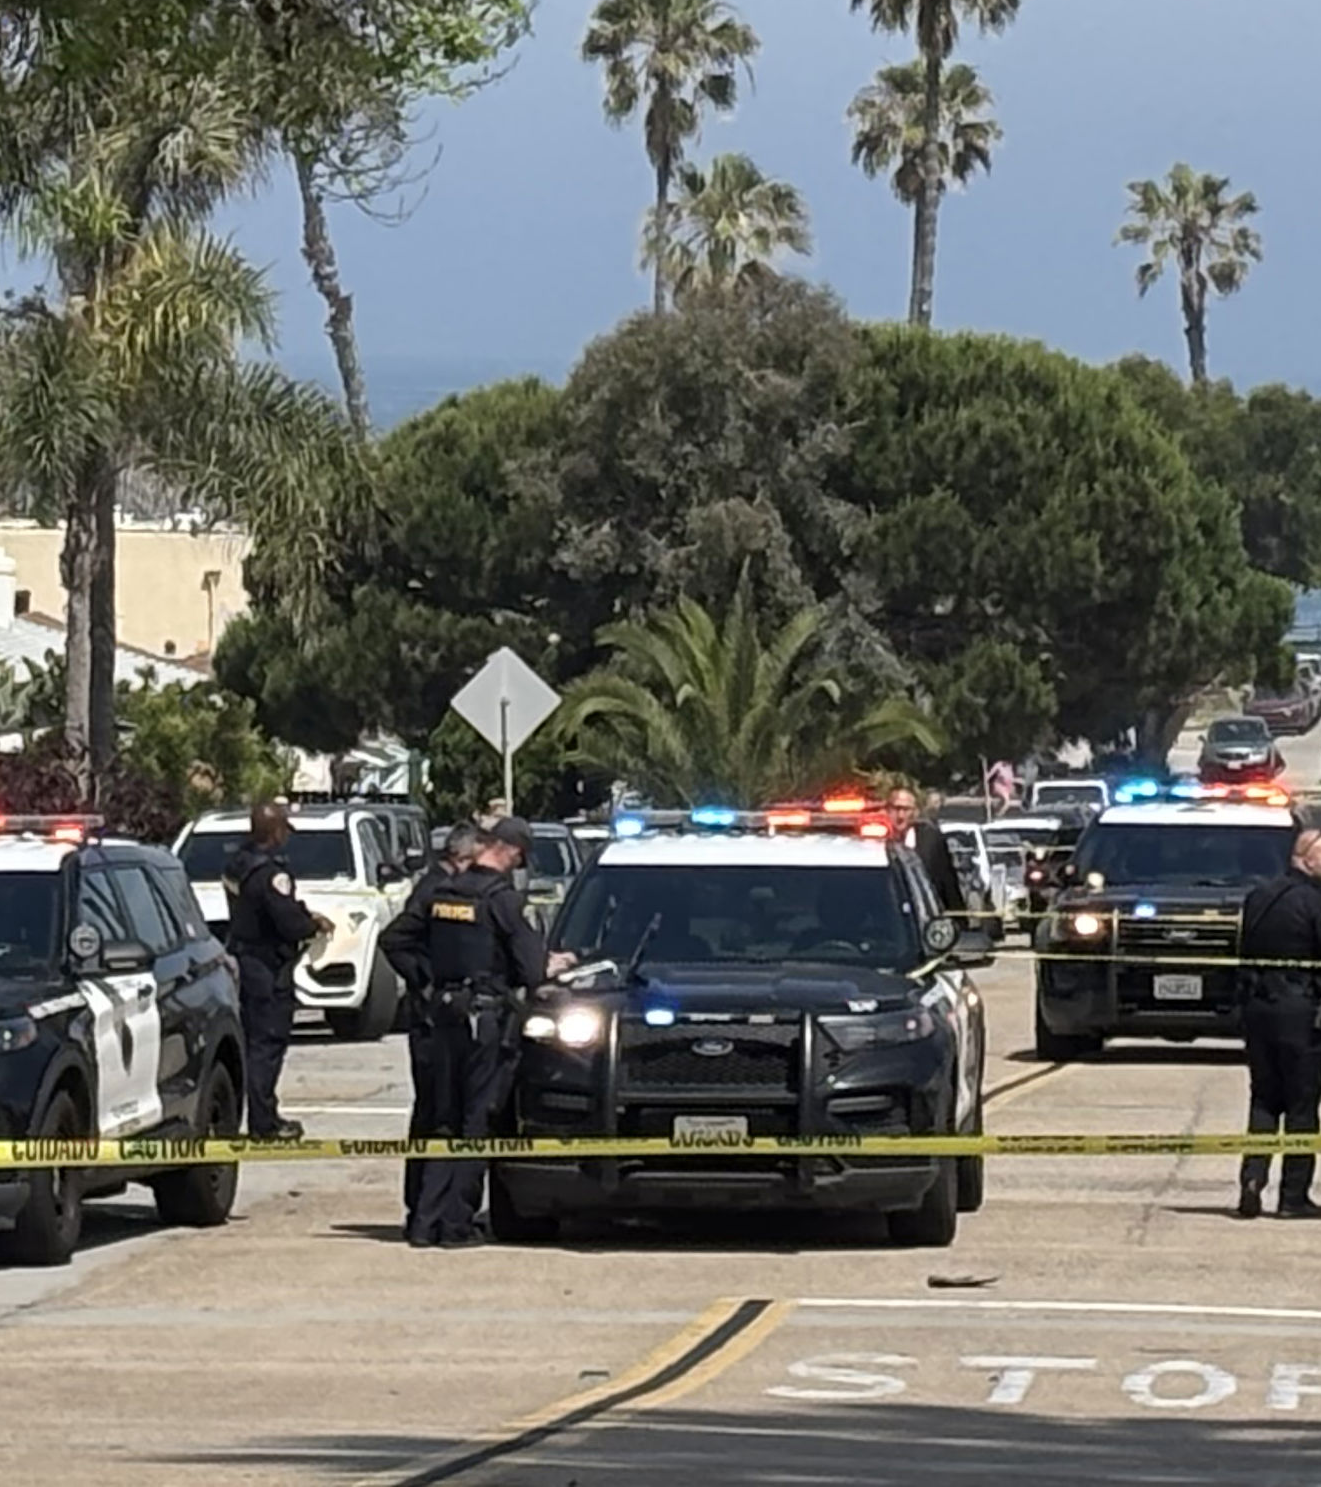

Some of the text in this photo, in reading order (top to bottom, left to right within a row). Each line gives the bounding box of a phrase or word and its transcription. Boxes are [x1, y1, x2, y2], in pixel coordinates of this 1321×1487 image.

[432, 902, 476, 922] POLICE
[10, 1137, 100, 1161] CUIDADO
[119, 1137, 206, 1160] CAUTION
